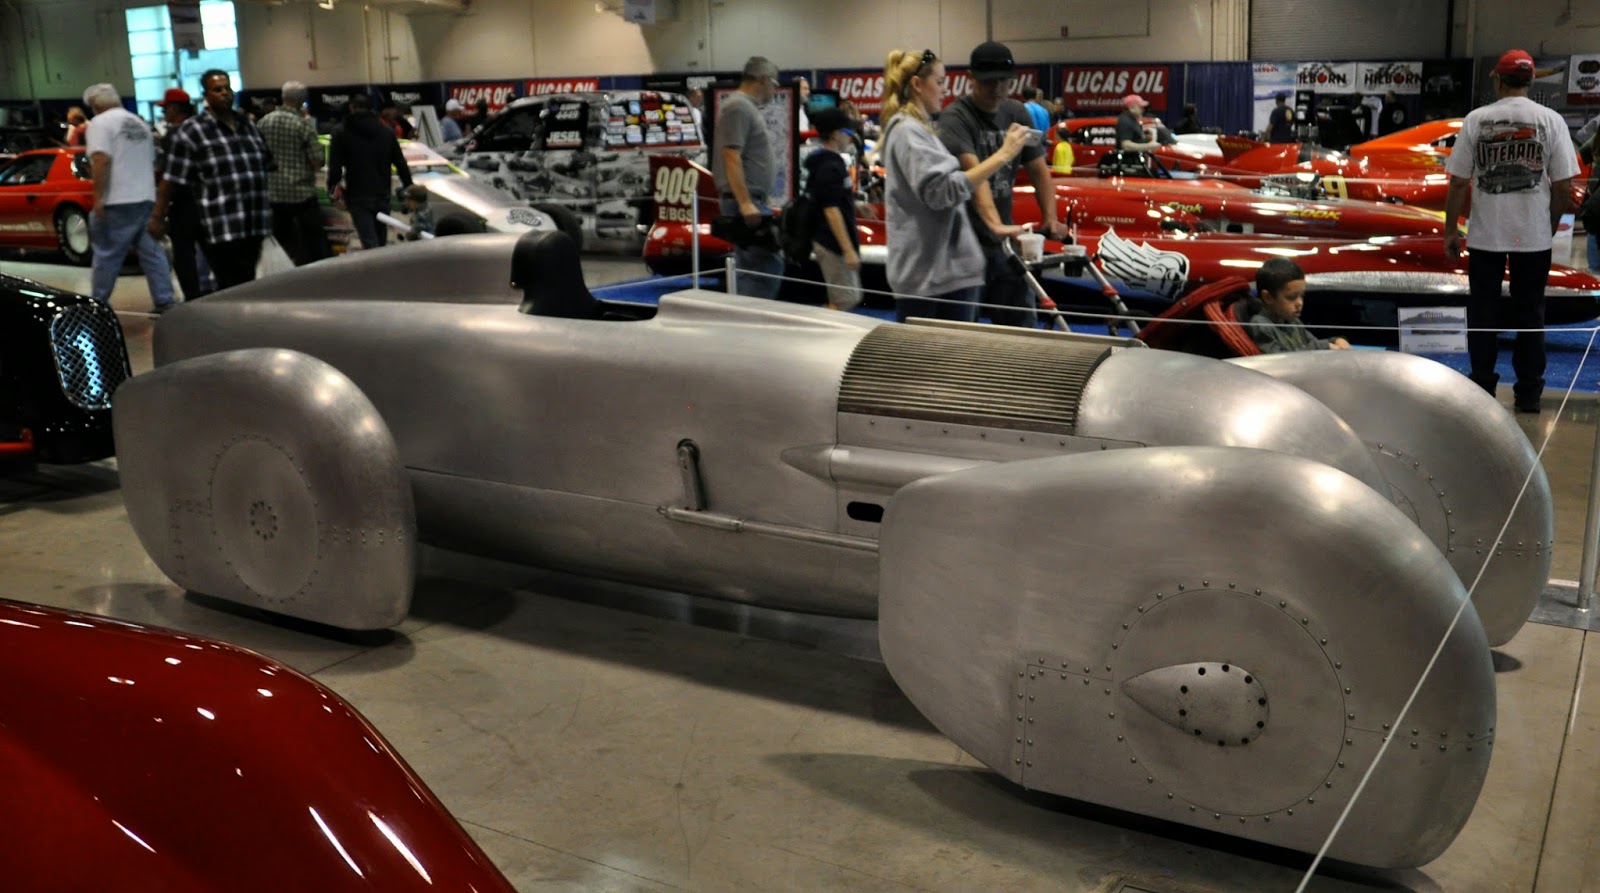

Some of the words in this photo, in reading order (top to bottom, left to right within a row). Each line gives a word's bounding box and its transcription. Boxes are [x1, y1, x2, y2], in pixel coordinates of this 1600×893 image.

[529, 81, 569, 96] LUCAS
[573, 80, 596, 93] OIL
[831, 76, 885, 98] LUCAS
[1064, 70, 1130, 93] LUCAS
[1132, 70, 1164, 93] OIL
[453, 87, 492, 106] LUCAS
[546, 131, 582, 142] JESEL
[653, 165, 699, 205] 909
[1322, 174, 1349, 199] 9
